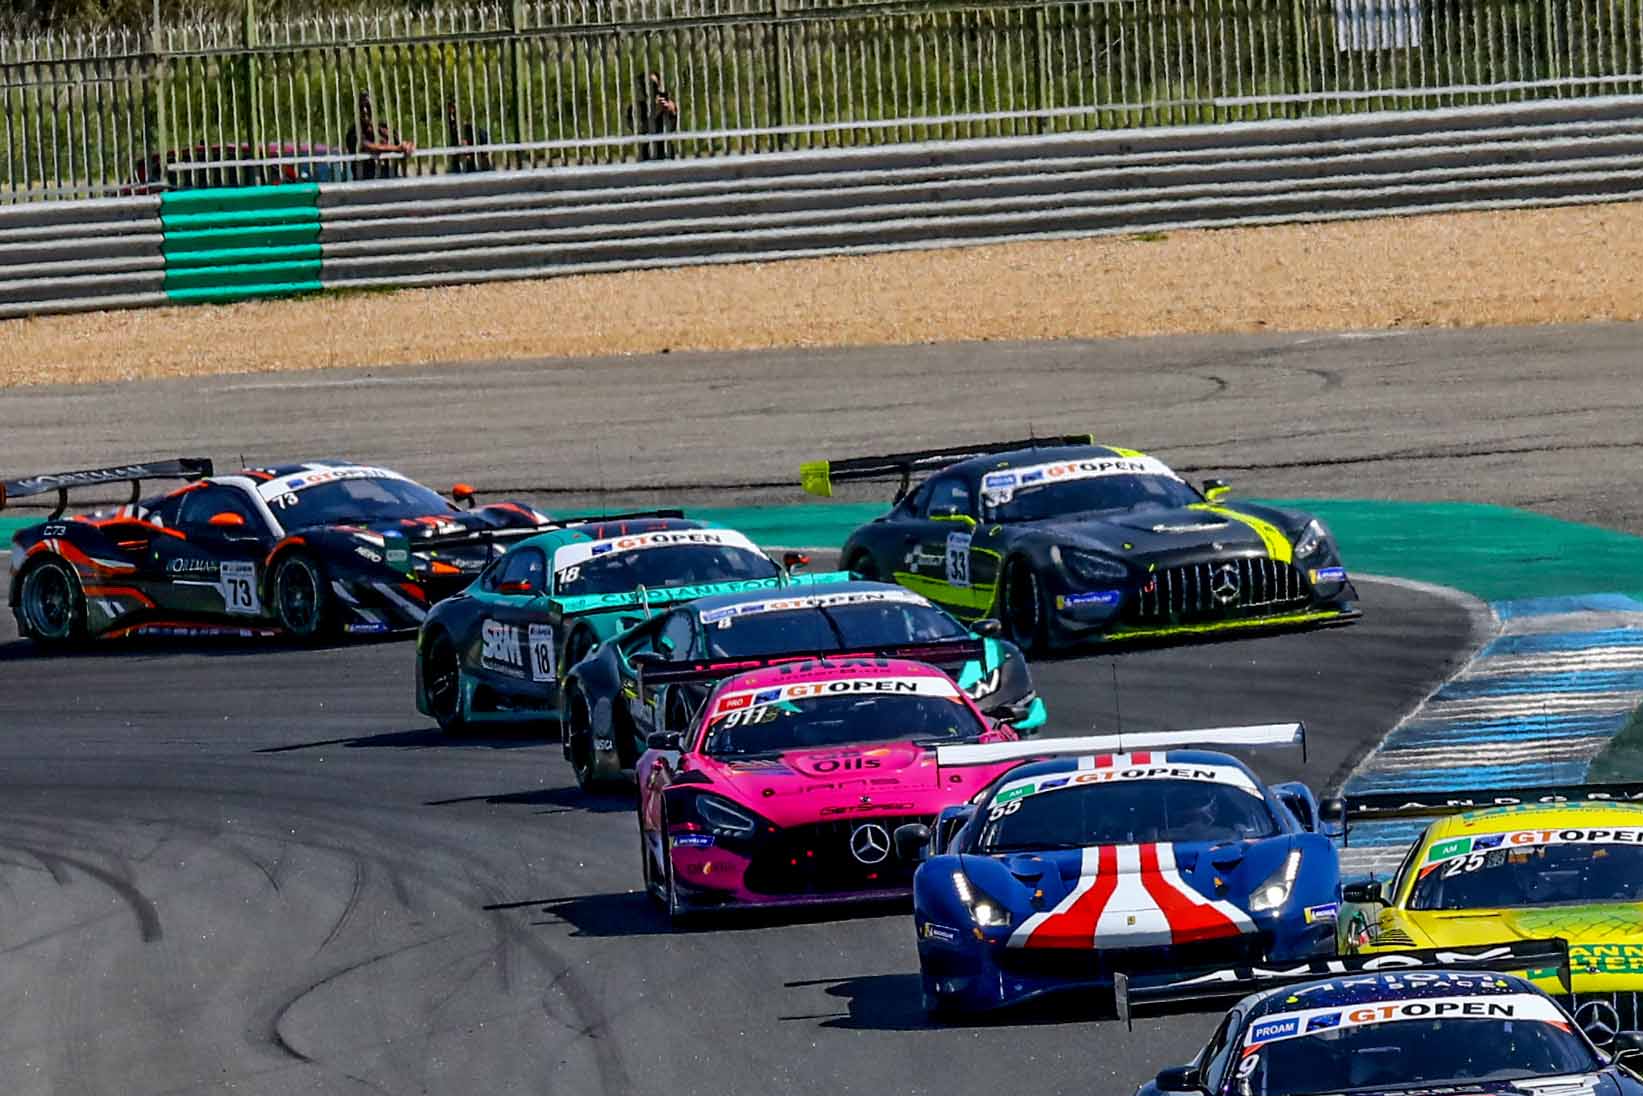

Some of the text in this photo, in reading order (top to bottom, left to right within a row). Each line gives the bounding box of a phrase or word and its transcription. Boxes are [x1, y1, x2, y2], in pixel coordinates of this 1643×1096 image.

[272, 493, 298, 509] 73
[616, 532, 722, 549] GTOPEN
[557, 567, 581, 583] 18
[951, 551, 966, 582] 33
[227, 579, 250, 607] 73
[770, 593, 885, 609] GTOPEN
[535, 643, 550, 673] 18
[787, 681, 918, 697] GTOPEN
[726, 706, 768, 729] 911
[812, 757, 881, 773] Oils
[1075, 767, 1216, 784] GTOPEN
[1008, 788, 1023, 798] AM
[989, 798, 1022, 821] 55
[1442, 846, 1457, 854] AM
[1445, 855, 1485, 878] 25
[1349, 1002, 1514, 1023] GTOPEN
[1256, 1022, 1295, 1037] PROAM
[1239, 1054, 1260, 1079] 9
